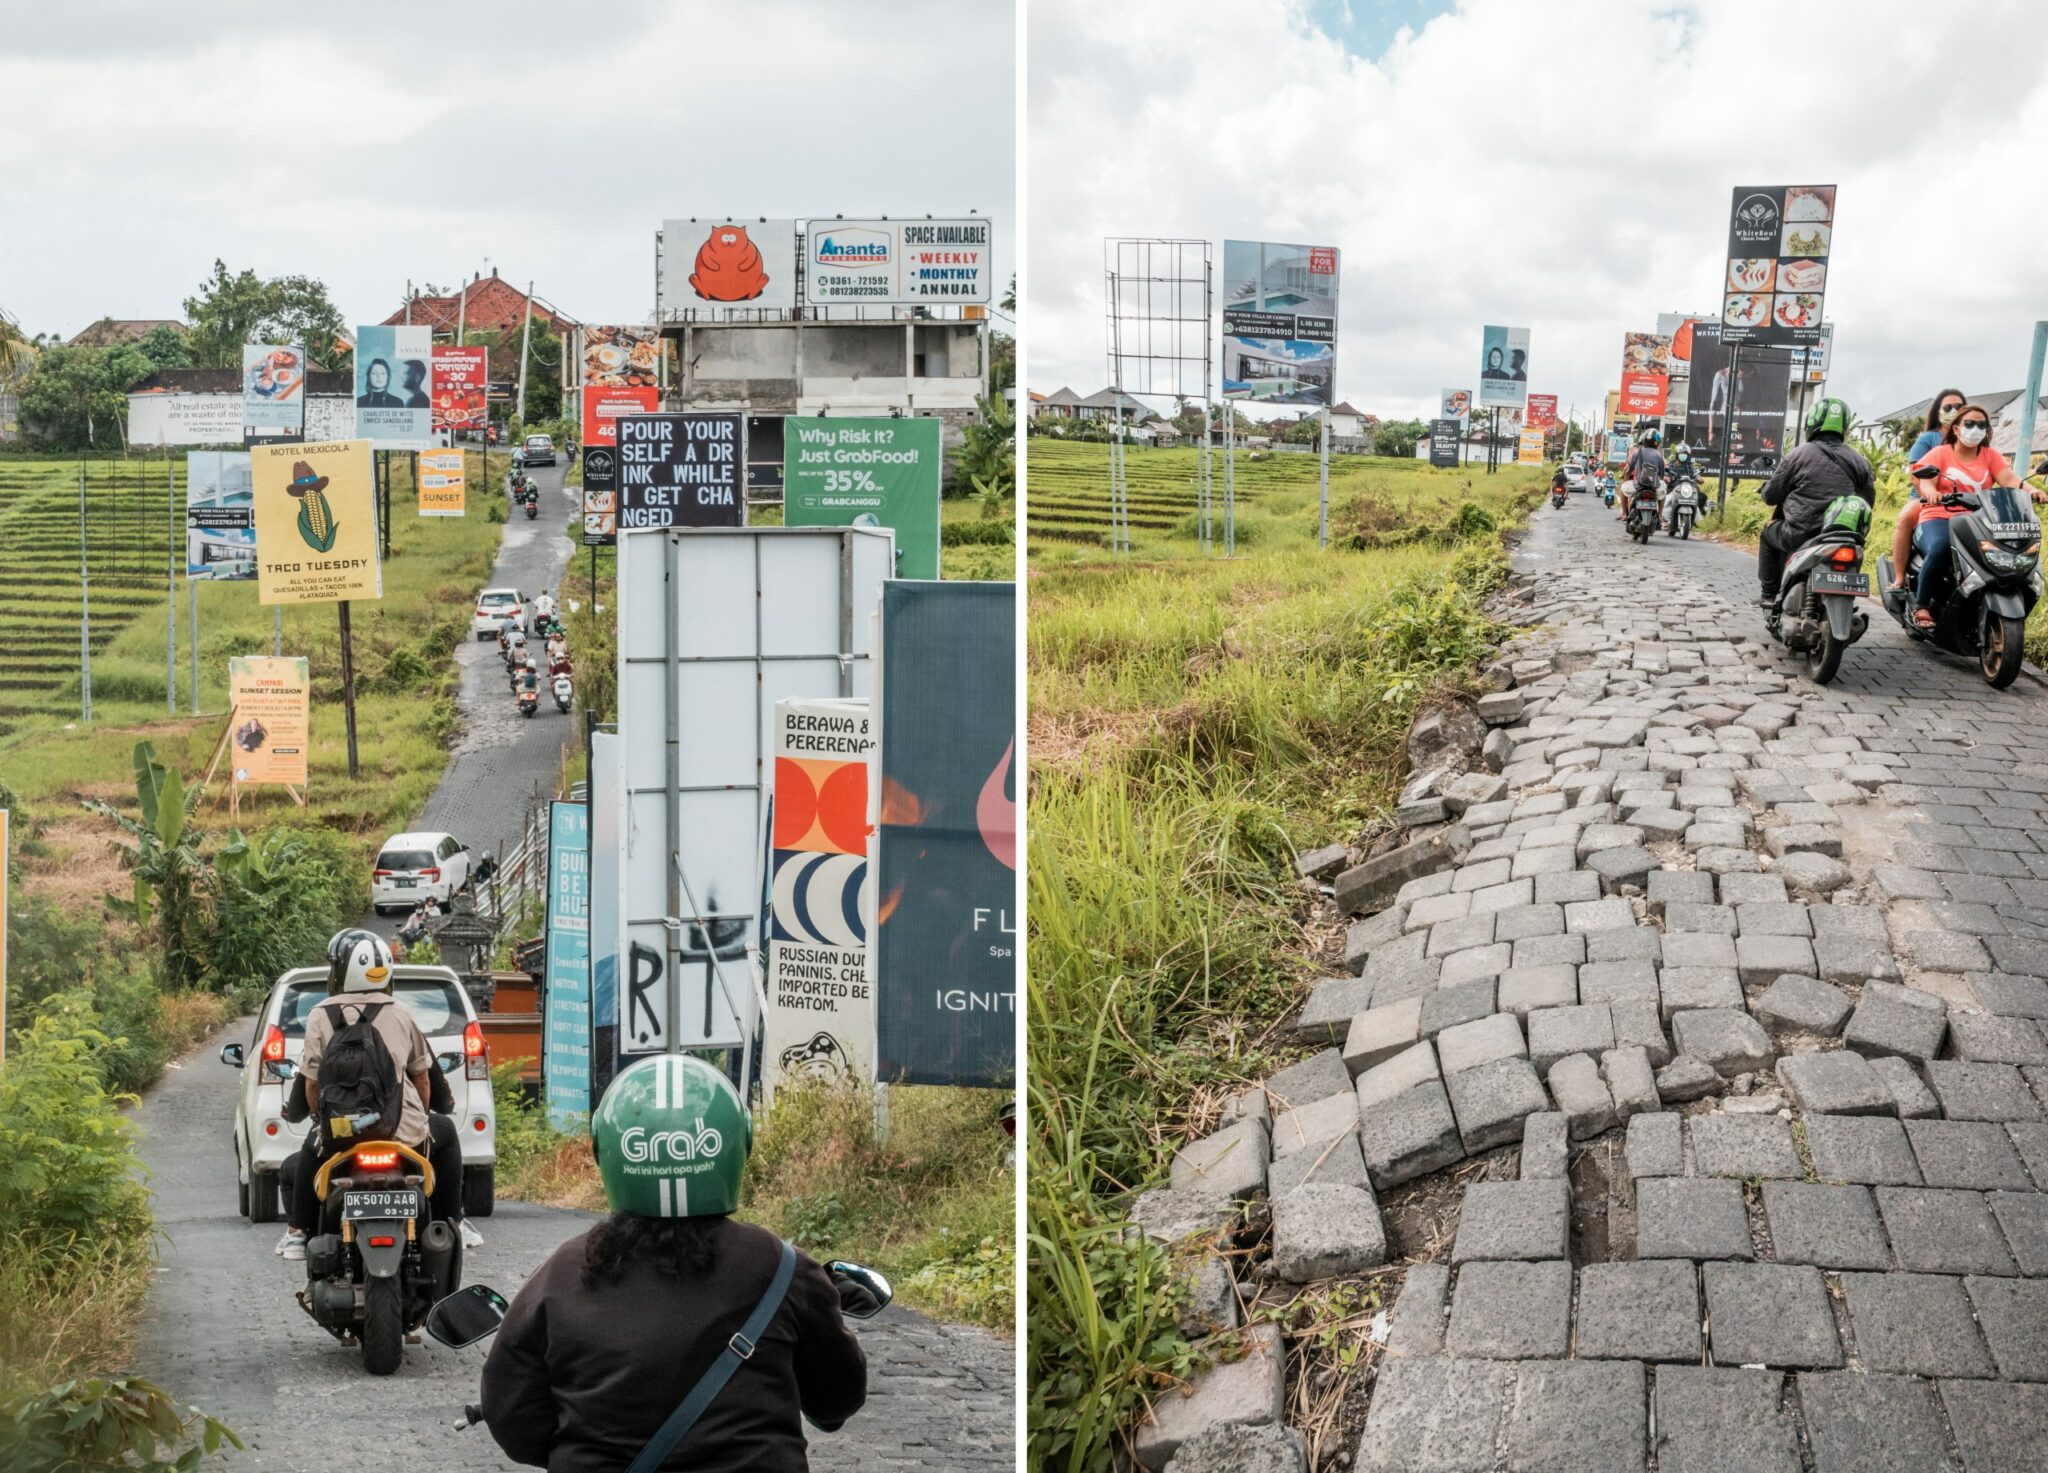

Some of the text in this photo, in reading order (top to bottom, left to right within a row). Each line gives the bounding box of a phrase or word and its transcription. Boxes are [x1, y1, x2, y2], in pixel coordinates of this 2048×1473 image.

[905, 226, 986, 244] SPACE AVAILABLE
[820, 236, 887, 256] Ananta
[920, 252, 978, 264] WEEKLY
[1314, 257, 1331, 265] FOR
[920, 268, 978, 280] MONTHLY
[1312, 264, 1333, 272] SALE
[830, 276, 852, 284] 0361
[858, 276, 888, 284] 721592
[830, 288, 888, 296] 081238223535
[920, 284, 977, 295] ANNUAL
[184, 402, 199, 410] real
[200, 402, 226, 410] estate
[622, 421, 734, 441] POUR YOUR
[799, 429, 894, 446] Why Risk It?
[270, 444, 350, 456] MOTEL MEXICOLA
[622, 444, 734, 462] SELF A DR
[798, 450, 918, 464] Just GrabFood!
[623, 465, 734, 484] INK WHILE
[824, 470, 876, 491] 35%
[423, 494, 460, 502] SUNSET
[624, 486, 734, 505] I GET CHA
[822, 498, 880, 506] GRABCANGGU
[622, 508, 673, 527] NGED
[266, 559, 368, 574] TACO TUESDAY
[1856, 576, 1866, 584] LF
[273, 586, 318, 594] QUESADILLAS
[786, 714, 854, 734] BERAWA
[780, 947, 838, 965] RUSSIAN
[990, 946, 1012, 958] Spa
[780, 963, 836, 980] PANINIS.
[779, 978, 870, 999] IMPORTED BE
[778, 994, 838, 1012] KRATOM.
[620, 1118, 722, 1162] Grab
[623, 1164, 640, 1174] Hari
[642, 1166, 652, 1175] ini
[652, 1166, 672, 1175] hari
[346, 1194, 360, 1206] DK
[364, 1194, 390, 1205] 5070
